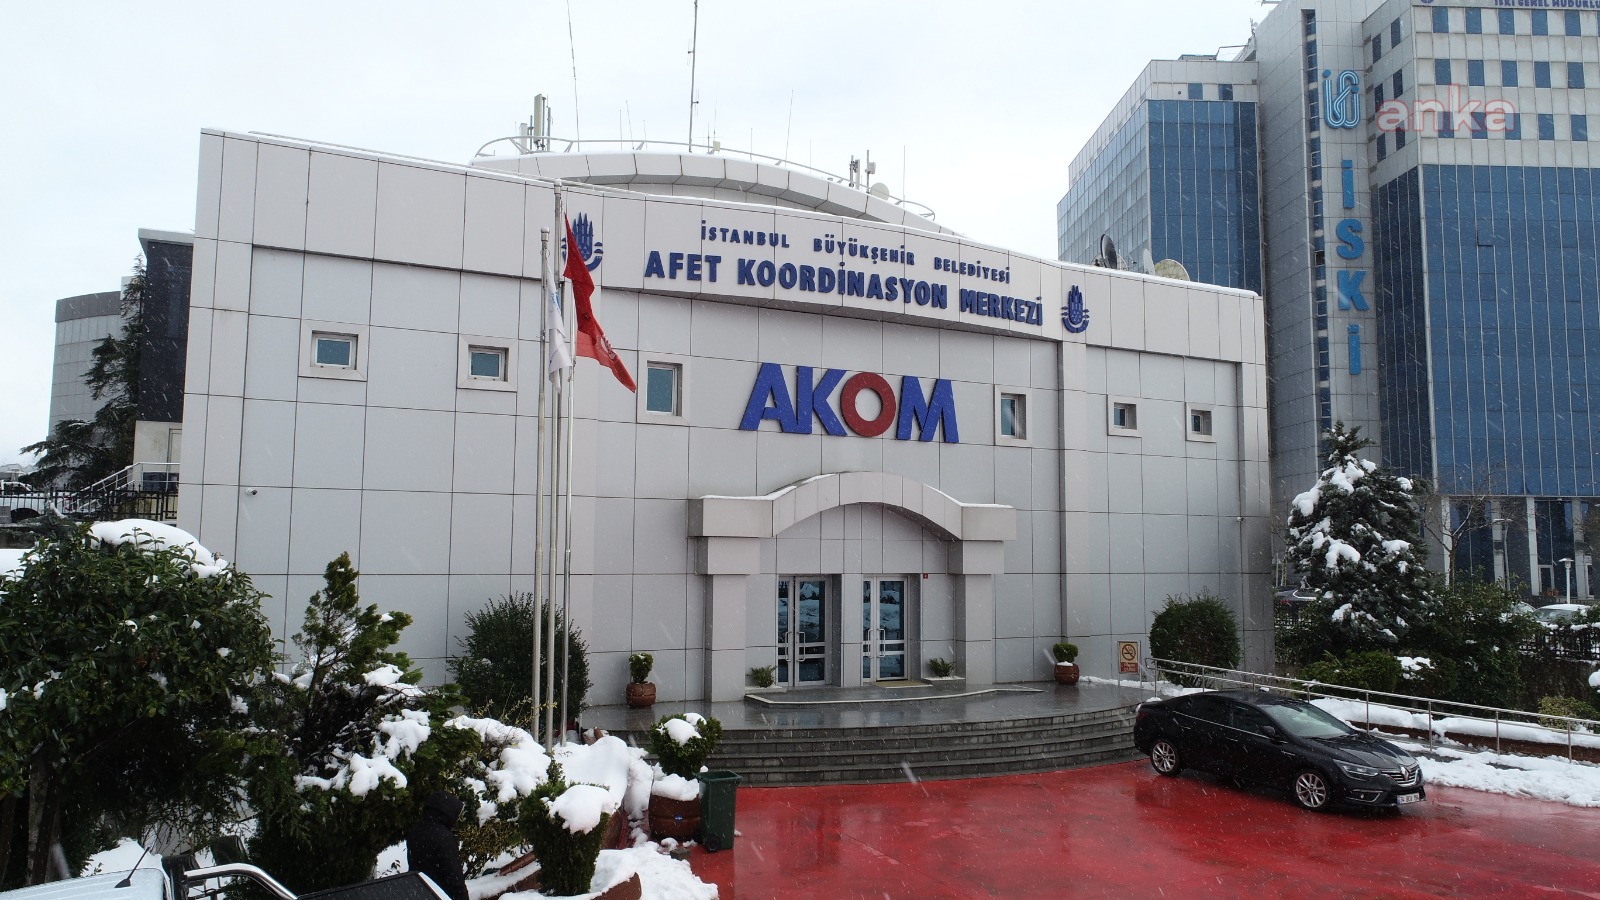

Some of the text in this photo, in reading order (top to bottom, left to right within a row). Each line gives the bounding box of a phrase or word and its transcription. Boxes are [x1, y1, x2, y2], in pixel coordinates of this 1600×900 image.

[644, 250, 1043, 326] AFET KOORDİNASYON MERKEZİ
[701, 220, 1010, 284] İSTANBUL BÜYÜKŞEHİR BELEDİYESİ
[739, 362, 959, 443] AKOM
